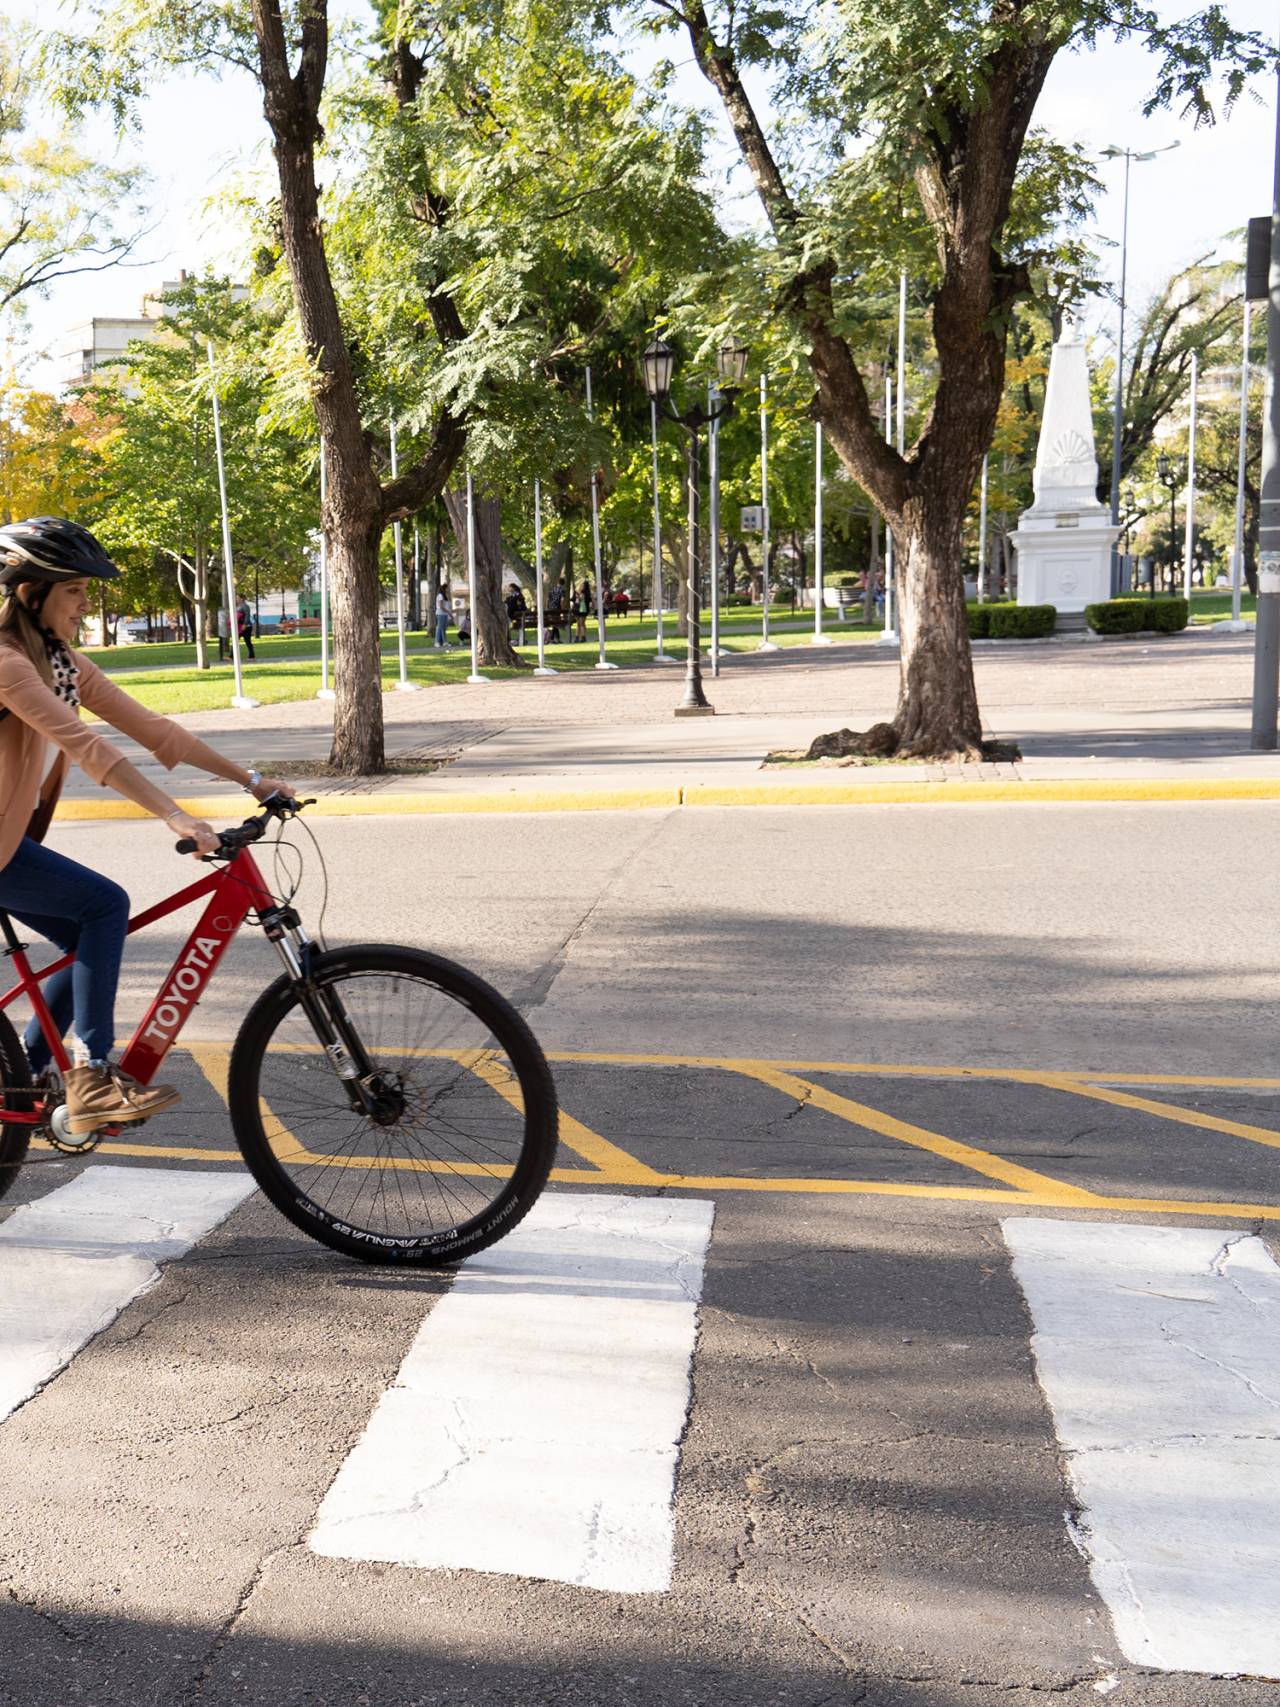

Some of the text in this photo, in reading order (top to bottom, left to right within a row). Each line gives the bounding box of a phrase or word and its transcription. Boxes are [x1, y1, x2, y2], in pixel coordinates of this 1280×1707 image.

[144, 936, 222, 1042] TOYOTA
[484, 1194, 520, 1231] MOUNT
[332, 1222, 352, 1236] 29
[351, 1230, 419, 1247] MAGNUM
[431, 1229, 484, 1255] EMMONS
